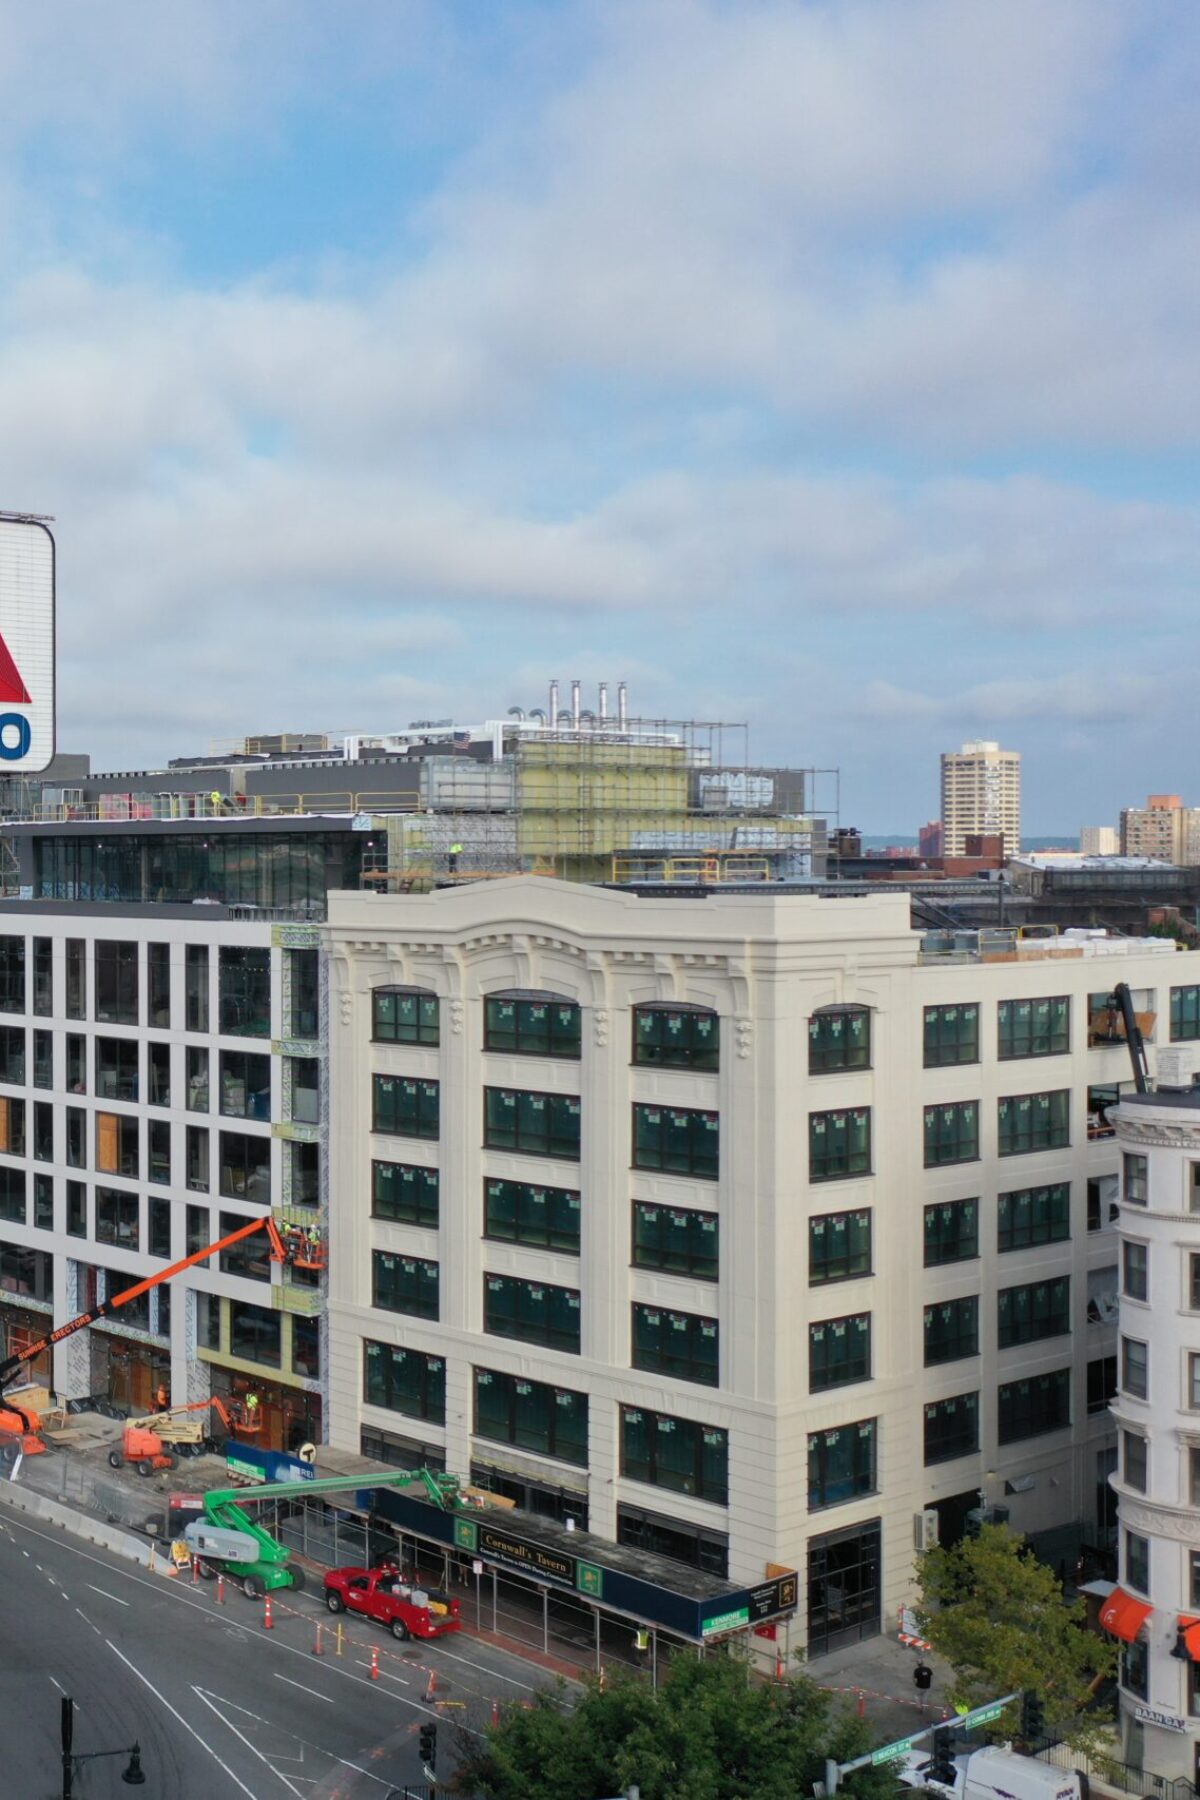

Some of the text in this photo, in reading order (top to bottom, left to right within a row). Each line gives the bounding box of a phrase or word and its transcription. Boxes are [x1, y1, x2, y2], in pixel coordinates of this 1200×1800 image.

[18, 1314, 92, 1360] SUNRISE ERECTORS
[302, 1449, 314, 1463] T
[485, 1535, 566, 1572] Cornwall's Tavern
[711, 1610, 740, 1626] KENMORE
[1135, 1707, 1163, 1723] BAAN
